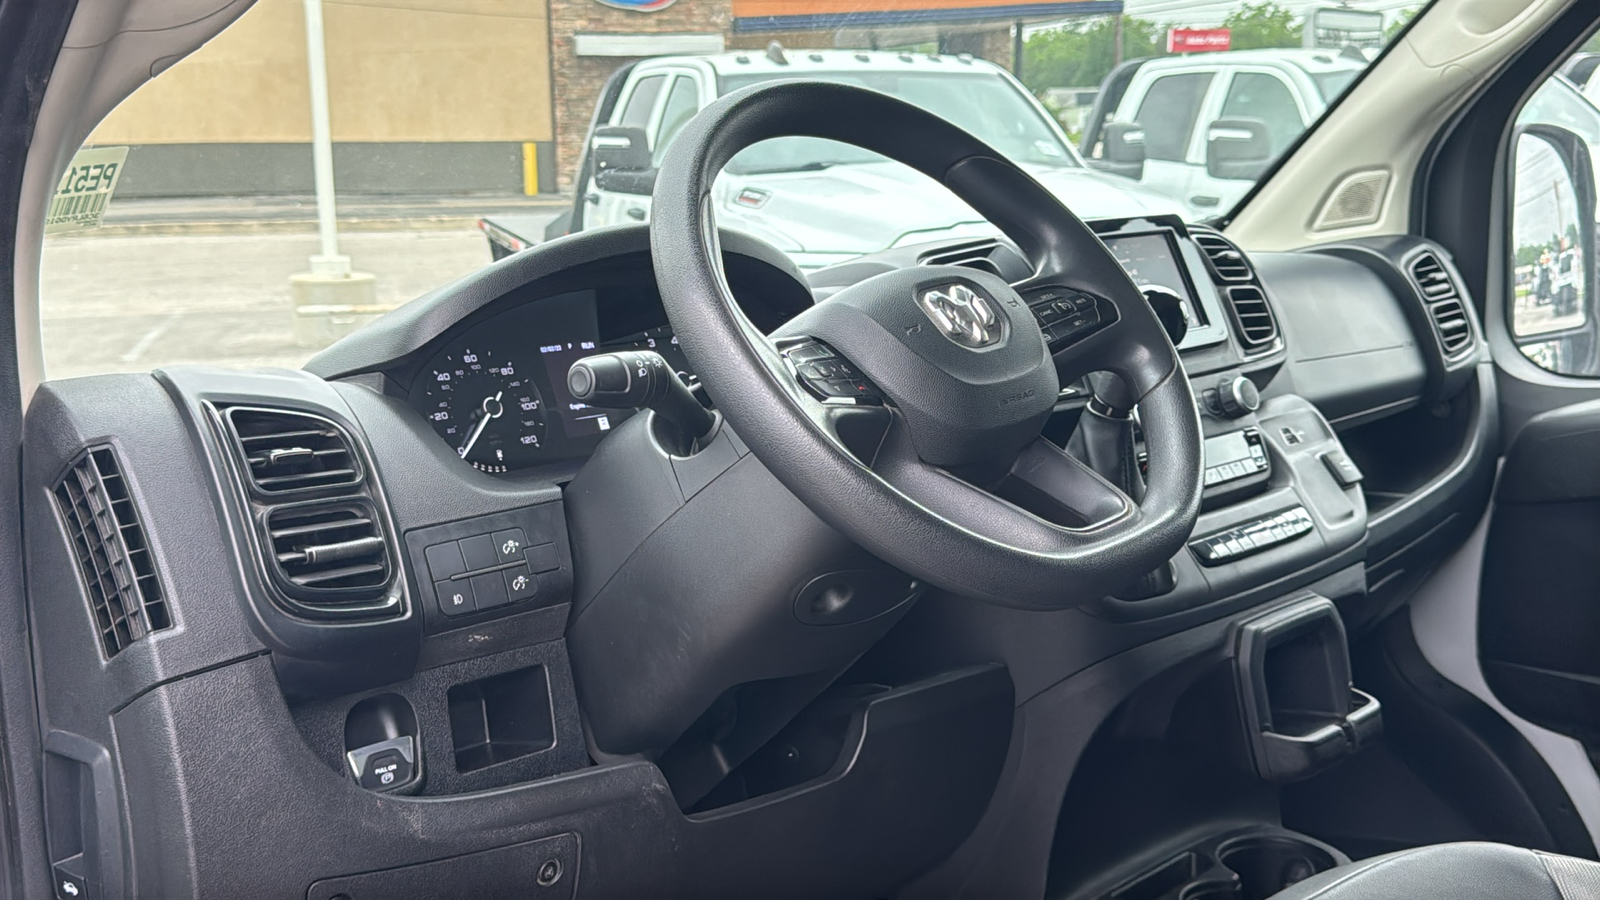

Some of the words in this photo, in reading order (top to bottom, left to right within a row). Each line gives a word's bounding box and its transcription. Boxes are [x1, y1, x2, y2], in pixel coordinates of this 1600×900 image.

[647, 338, 656, 348] 3
[670, 335, 679, 345] 4
[581, 341, 596, 350] RUN
[463, 354, 478, 363] 60
[500, 367, 514, 375] 80
[437, 372, 451, 381] 40
[521, 402, 537, 411] 100
[434, 411, 449, 421] 20
[520, 435, 537, 444] 120
